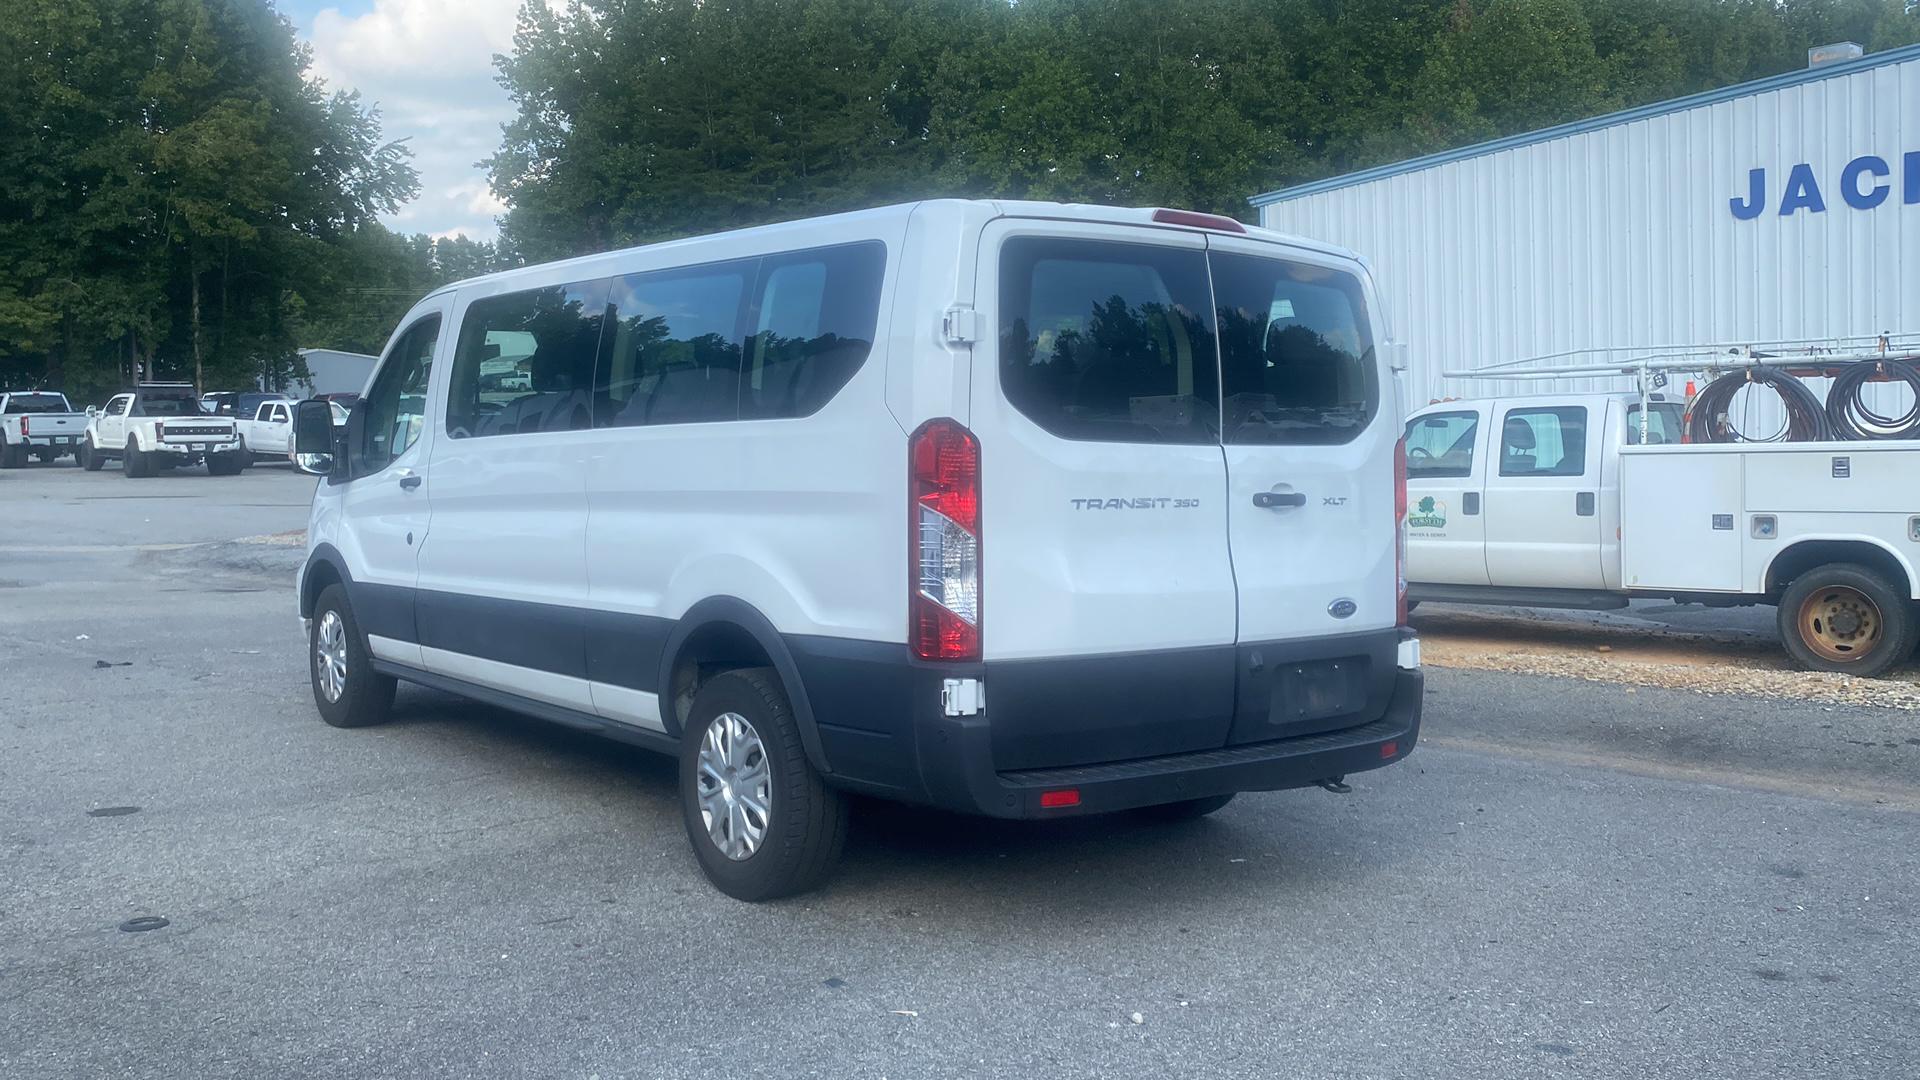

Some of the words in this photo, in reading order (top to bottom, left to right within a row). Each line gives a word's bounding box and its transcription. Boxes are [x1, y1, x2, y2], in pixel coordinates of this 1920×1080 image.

[1070, 497, 1171, 510] TRANSIT
[1173, 498, 1200, 508] 350
[1322, 497, 1347, 506] XLT
